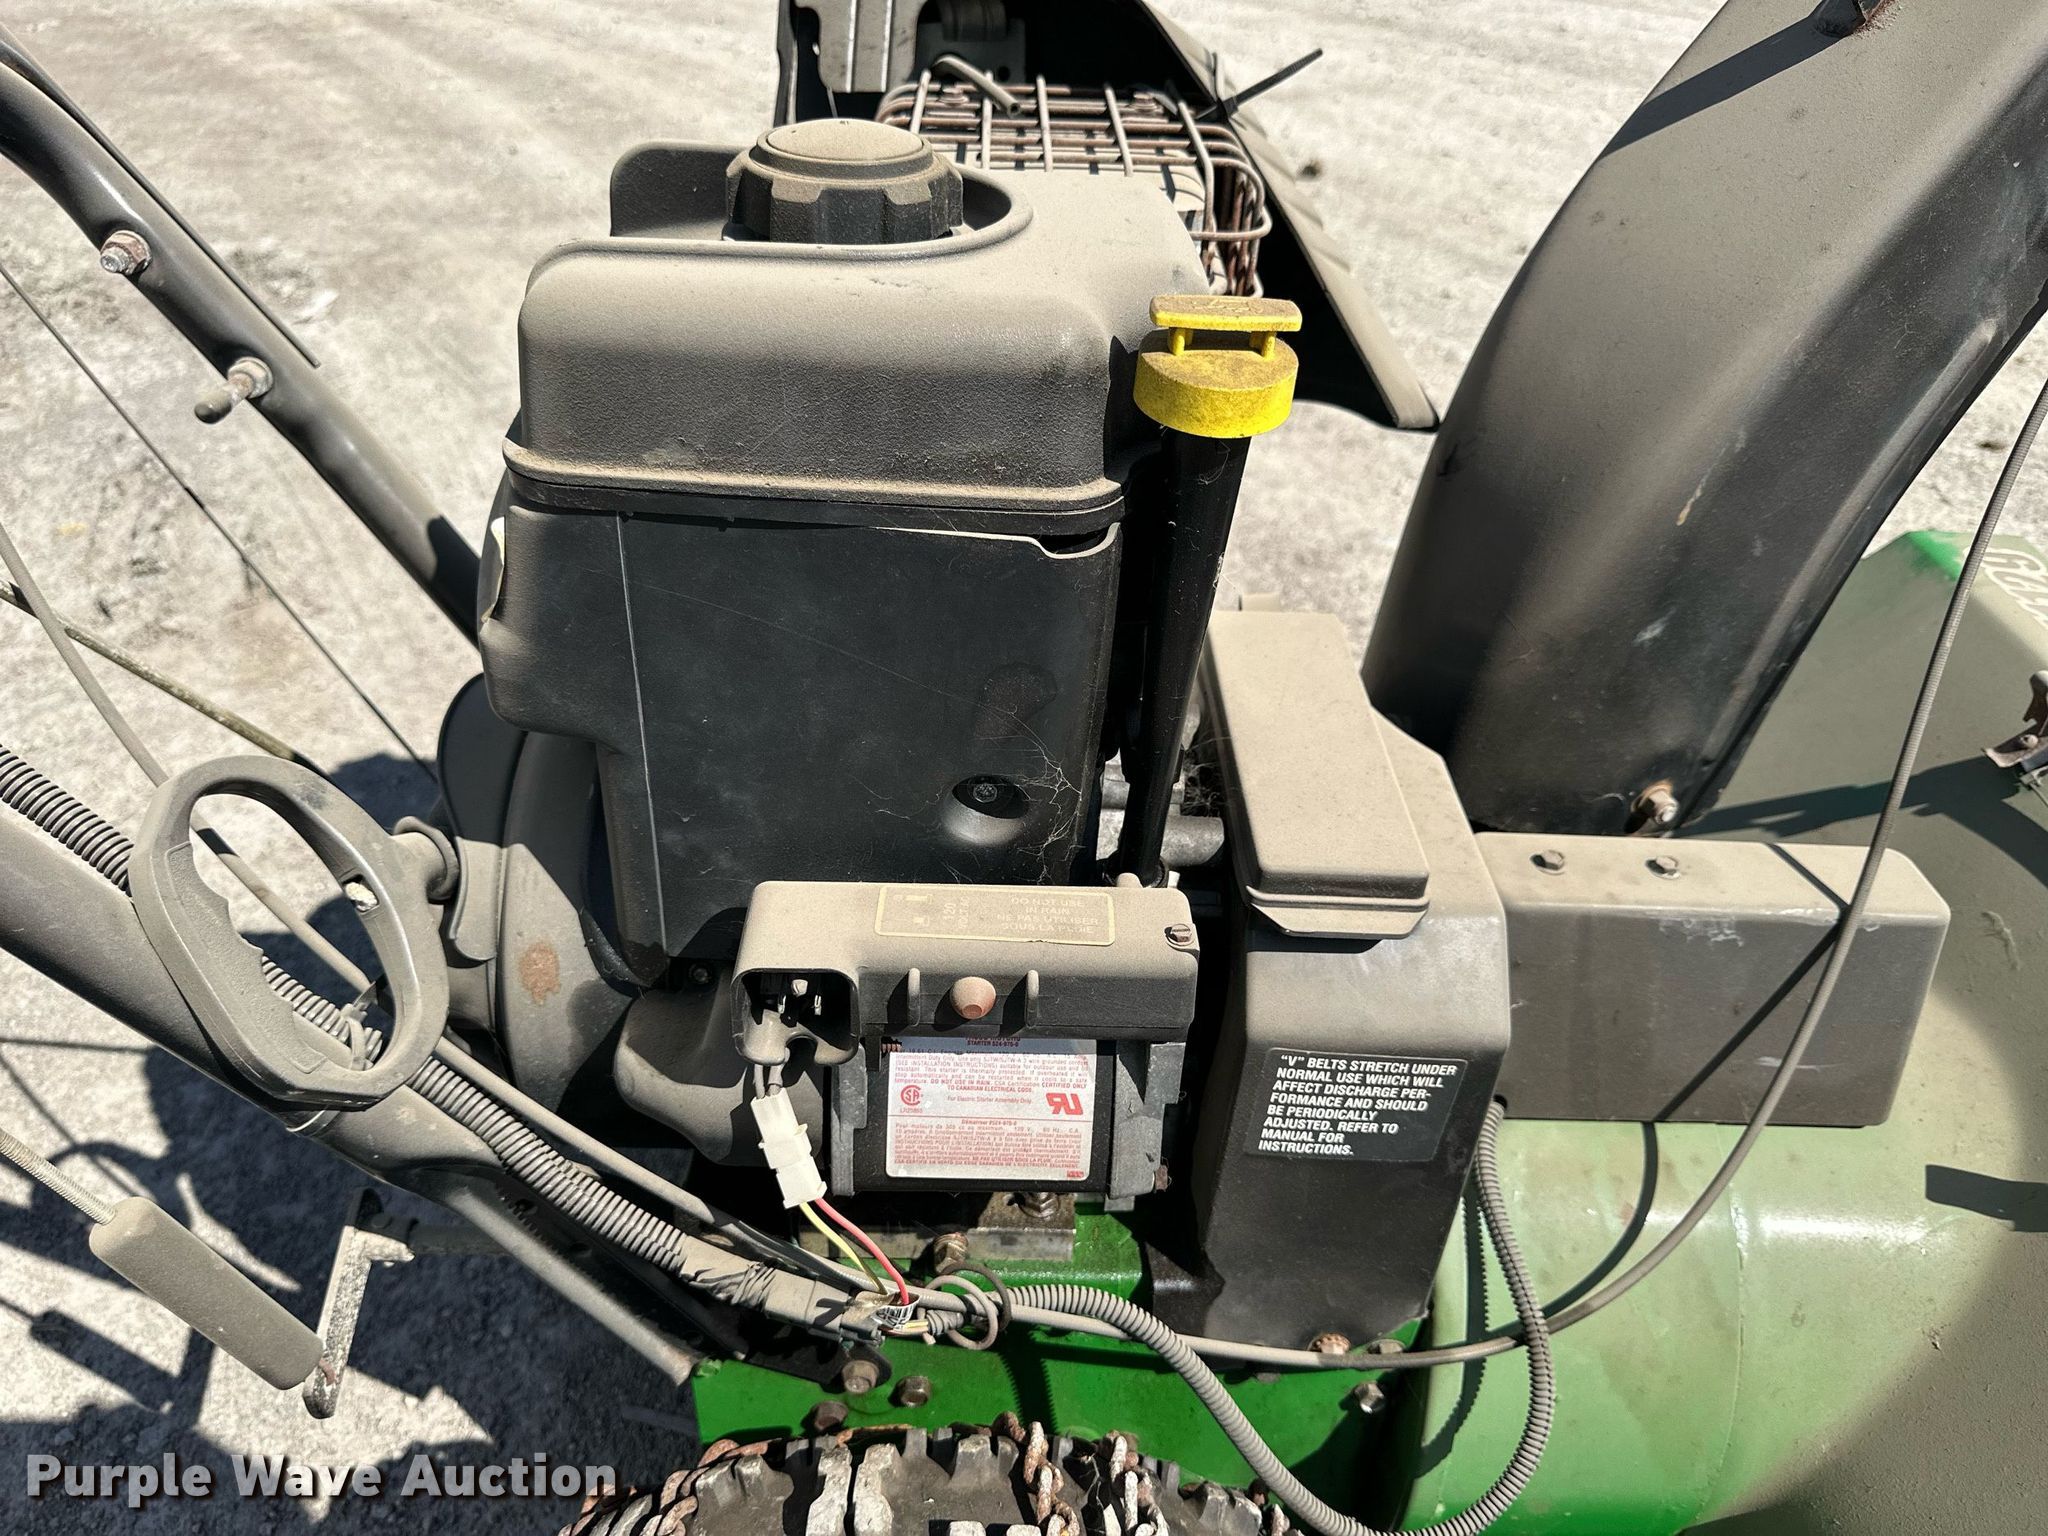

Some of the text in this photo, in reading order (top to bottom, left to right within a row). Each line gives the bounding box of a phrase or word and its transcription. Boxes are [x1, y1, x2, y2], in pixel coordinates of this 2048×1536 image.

[1307, 1058, 1348, 1071] BELTS
[1350, 1060, 1410, 1074] STRETCH
[1412, 1064, 1458, 1076] UNDER
[1276, 1068, 1444, 1088] NORMAL USE WHICH WILL
[1272, 1080, 1432, 1100] AFFECT DISCHARGE PER-
[1270, 1092, 1428, 1112] FORMANCE AND SHOULD
[1267, 1104, 1378, 1121] BE PERIODICALLY
[1263, 1116, 1399, 1134] ADJUSTED. REFER TO
[1261, 1128, 1345, 1143] MANUAL FOR
[1258, 1140, 1354, 1156] INSTRUCTIONS.
